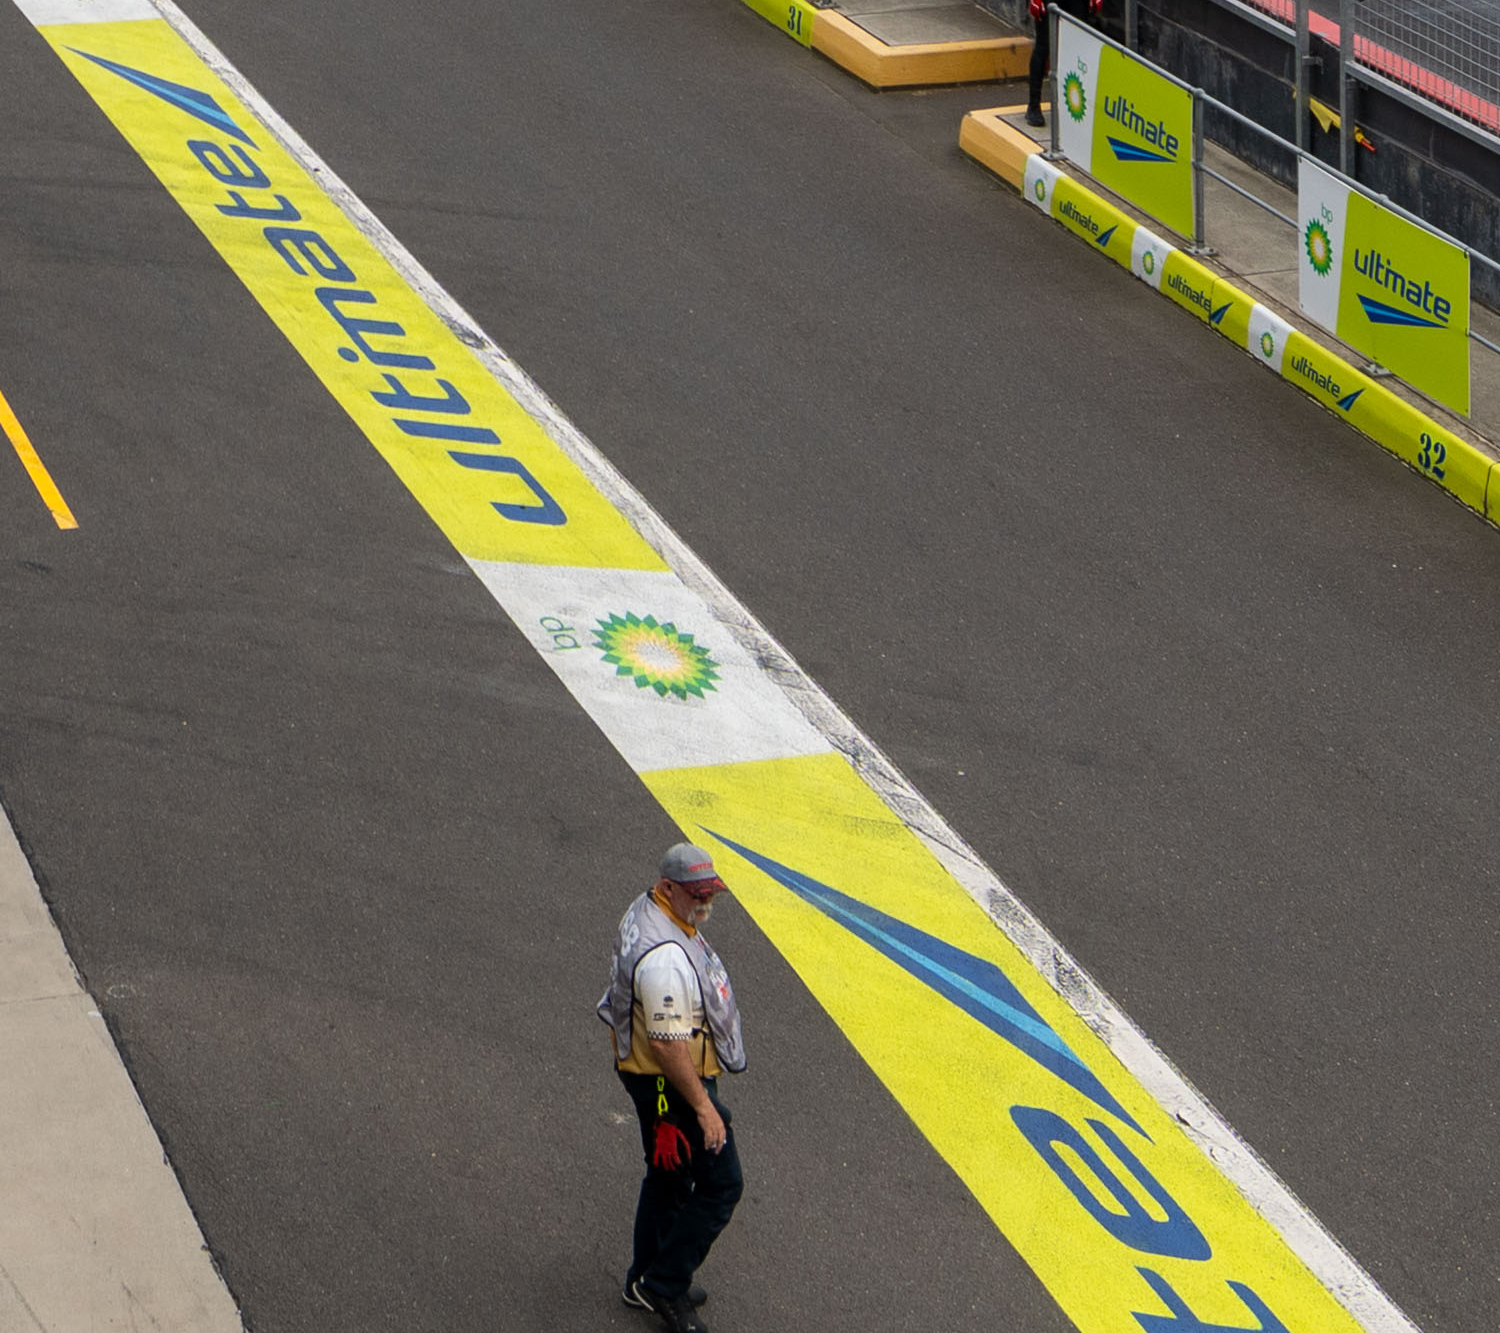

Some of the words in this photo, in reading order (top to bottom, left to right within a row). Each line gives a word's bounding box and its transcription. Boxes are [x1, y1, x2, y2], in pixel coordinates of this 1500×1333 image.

[786, 4, 802, 35] 31
[1077, 57, 1088, 76] bp
[1103, 94, 1180, 158] ultimate
[1059, 200, 1099, 236] ultimate
[1320, 202, 1334, 225] bp
[1167, 273, 1213, 312] ultimate
[1353, 244, 1452, 325] ultimate
[186, 138, 569, 526] ultimate
[1291, 355, 1341, 398] ultimate
[1418, 432, 1447, 480] 32
[538, 615, 582, 656] bp
